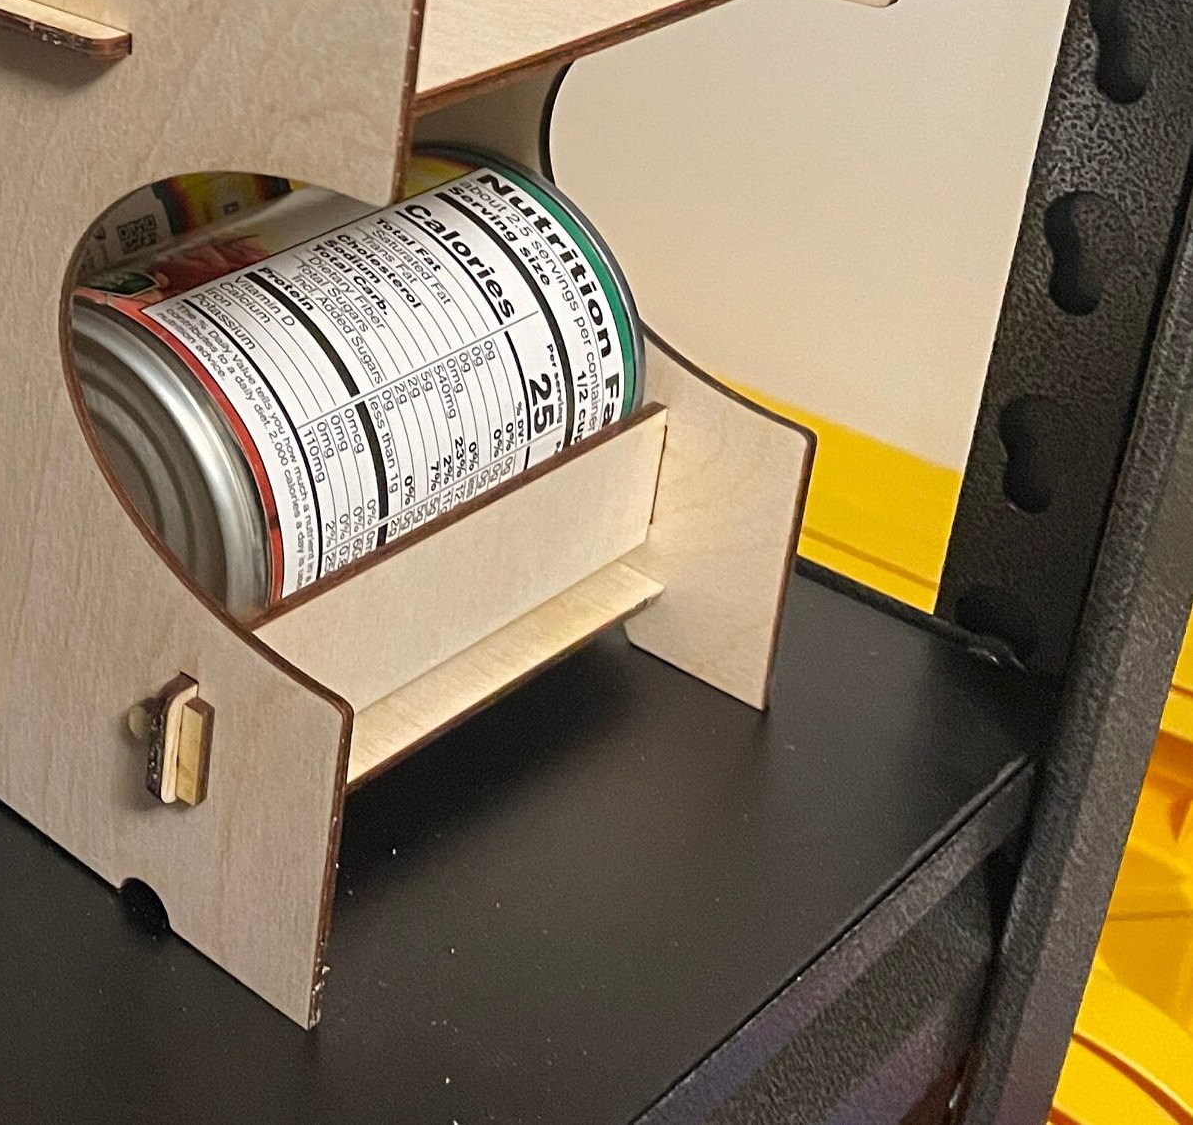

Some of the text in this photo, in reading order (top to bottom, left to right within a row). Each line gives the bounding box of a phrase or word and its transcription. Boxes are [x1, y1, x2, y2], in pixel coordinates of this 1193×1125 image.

[157, 313, 196, 344] nutrition
[297, 263, 407, 405] Total Sugars 2g
[308, 257, 355, 294] Dietary
[354, 292, 387, 329] Fiber
[408, 377, 420, 398] 2g
[431, 461, 441, 491] 7%
[313, 244, 350, 274] Total
[353, 276, 388, 316] Carb.
[420, 371, 433, 392] 5g
[443, 455, 454, 485] 2%
[324, 239, 381, 284] Sodium
[434, 365, 457, 420] 540mg
[455, 437, 466, 478] 23%
[337, 234, 422, 309] Cholesterol
[447, 358, 464, 393] 0mg
[468, 442, 479, 471] 0%
[361, 235, 395, 263] Trans
[395, 264, 418, 285] Fat
[459, 353, 471, 373] 0g
[372, 229, 432, 281] Saturated
[431, 282, 452, 305] Fat
[472, 347, 484, 367] 0g
[493, 429, 503, 458] 0%
[376, 218, 416, 250] Total
[415, 247, 442, 273] Fat
[484, 340, 496, 361] 0g
[505, 422, 515, 452] 0%
[405, 204, 515, 319] Calories
[448, 186, 519, 242] Serving
[520, 246, 550, 286] size
[576, 371, 589, 403] 1/2
[459, 181, 600, 431] about 2.5 servings per container
[476, 173, 619, 427] Nutrition Fa
[166, 308, 218, 353] contributes
[217, 353, 228, 364] to
[235, 376, 256, 402] daily
[268, 432, 289, 466] 2,000
[284, 469, 301, 518] calories
[297, 531, 305, 553] day
[191, 293, 256, 350] Potassium
[303, 429, 325, 484] 110mg
[325, 520, 336, 548] 2%
[205, 289, 232, 307] Iron
[317, 422, 334, 459] 0mg
[339, 513, 349, 540] 0%
[208, 330, 233, 354] Daily
[233, 354, 256, 385] Value
[255, 386, 273, 411] tells
[268, 412, 286, 435] you
[282, 437, 297, 463] how
[294, 466, 308, 501] much
[305, 515, 315, 560] nutrient
[219, 282, 363, 533] Calcium 0mg 0%
[234, 276, 376, 525] Vitamin D 0mcg 0%
[258, 267, 313, 312] Protein
[368, 397, 384, 429] less
[382, 432, 396, 468] than
[389, 474, 399, 494] 1g
[318, 298, 354, 334] Added
[351, 336, 383, 385] Sugars
[382, 390, 395, 412] 0g
[404, 476, 415, 505] 0%
[529, 373, 555, 433] 25
